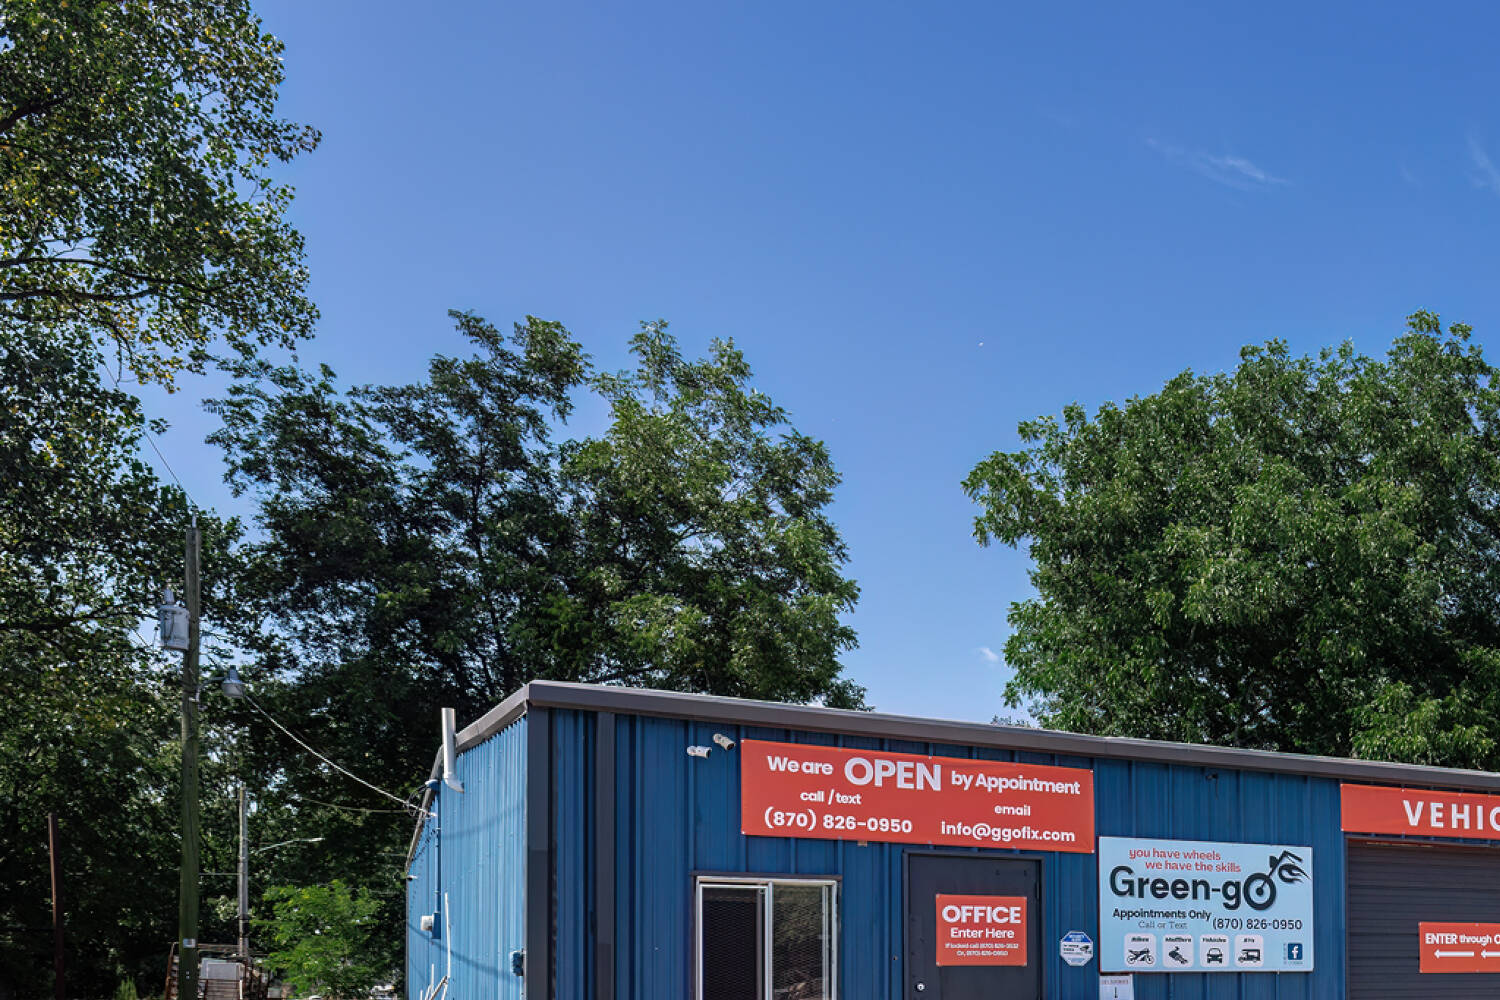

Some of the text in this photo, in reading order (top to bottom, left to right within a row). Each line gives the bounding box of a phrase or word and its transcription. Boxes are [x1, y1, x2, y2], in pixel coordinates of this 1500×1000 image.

[768, 755, 1081, 795] We are OPEN by Appointment
[800, 790, 824, 803] call
[994, 803, 1031, 817] email
[764, 806, 913, 834] (870) 826-0950
[941, 820, 1076, 842] info@ggofix.com
[1129, 848, 1221, 861] you have wheels
[1145, 860, 1242, 873] we have the skills
[1110, 865, 1277, 911] Green-go
[942, 905, 1021, 923] OFFICE
[1112, 908, 1212, 922] Appointments Only
[1138, 919, 1188, 930] Call or Text
[1212, 917, 1303, 931] (870) 826-0950
[950, 928, 1015, 939] Enter Here
[1425, 932, 1458, 945] ENTER
[1459, 933, 1492, 947] through
